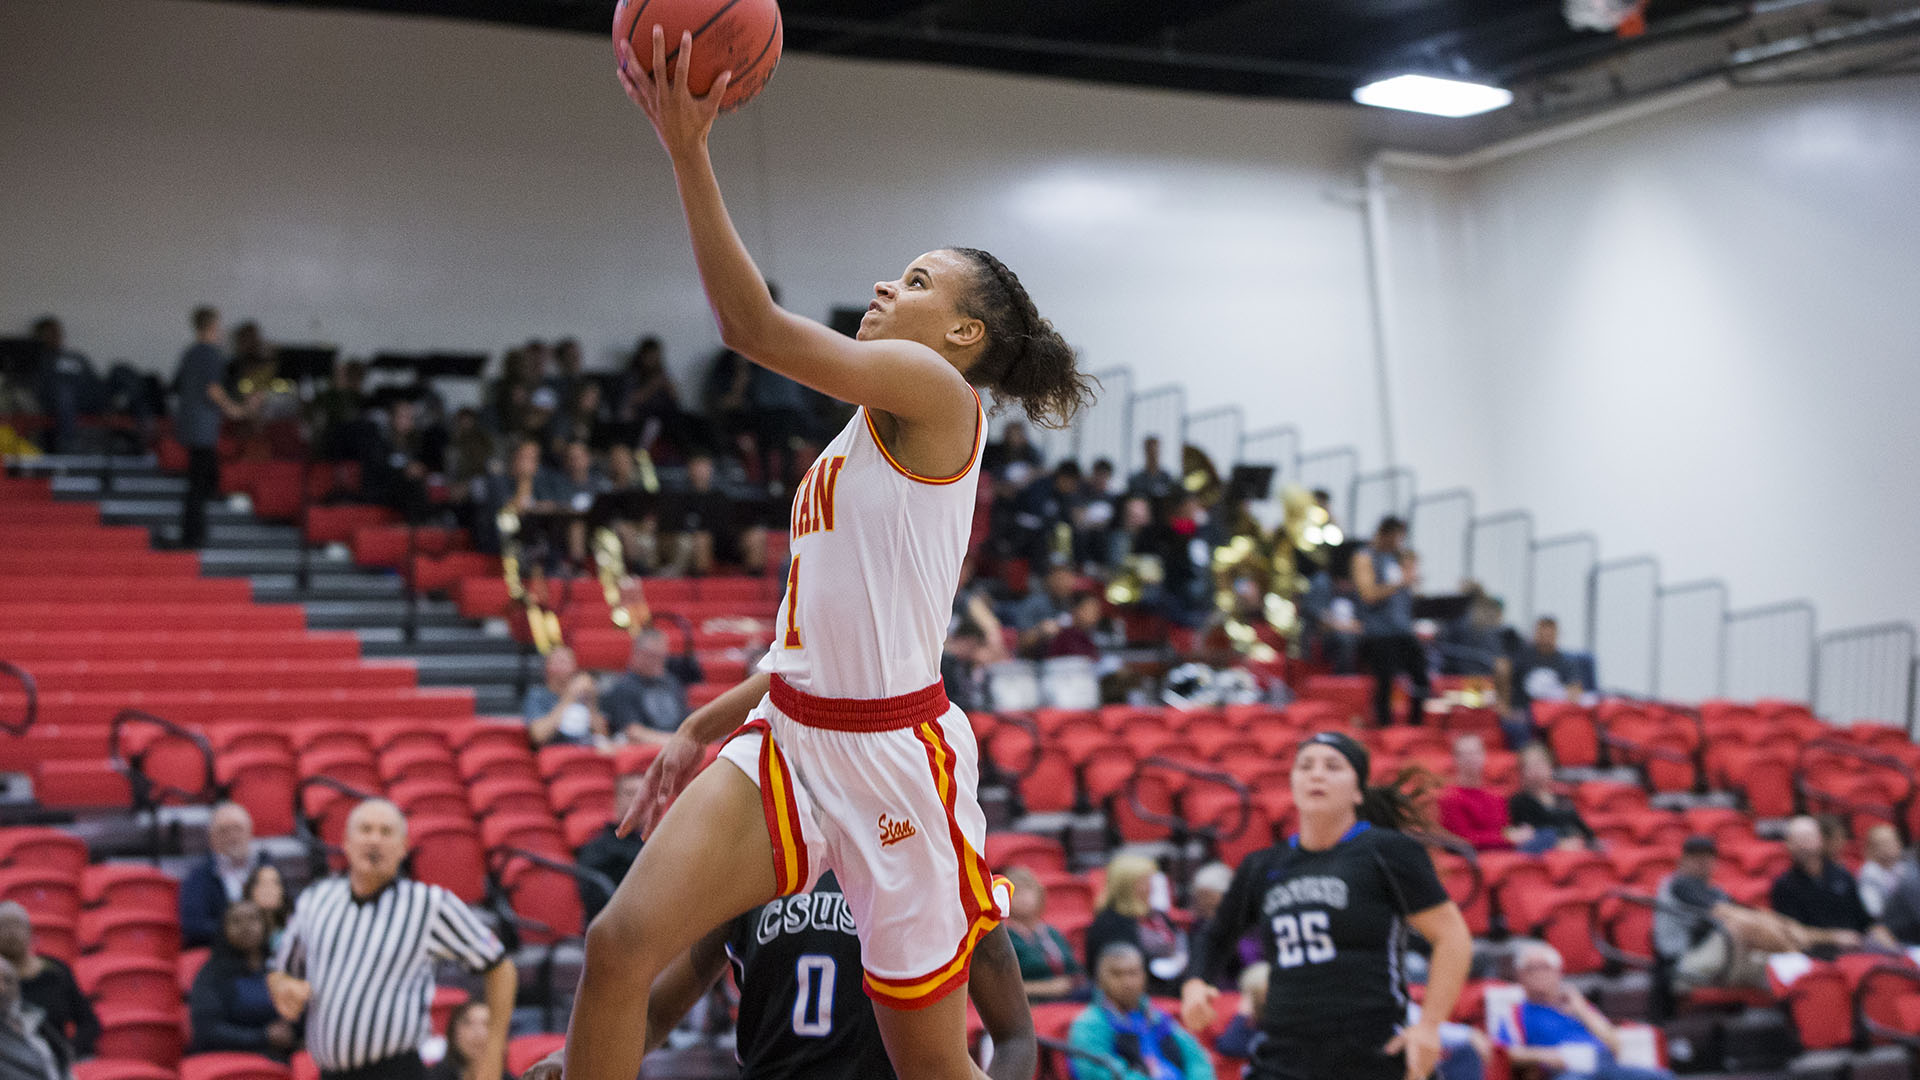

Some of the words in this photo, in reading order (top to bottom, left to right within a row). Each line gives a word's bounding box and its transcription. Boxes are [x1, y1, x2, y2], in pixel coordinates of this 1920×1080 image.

[785, 554, 803, 649] 1
[878, 813, 916, 847] Stan
[1271, 910, 1337, 969] 25
[792, 954, 838, 1037] 0
